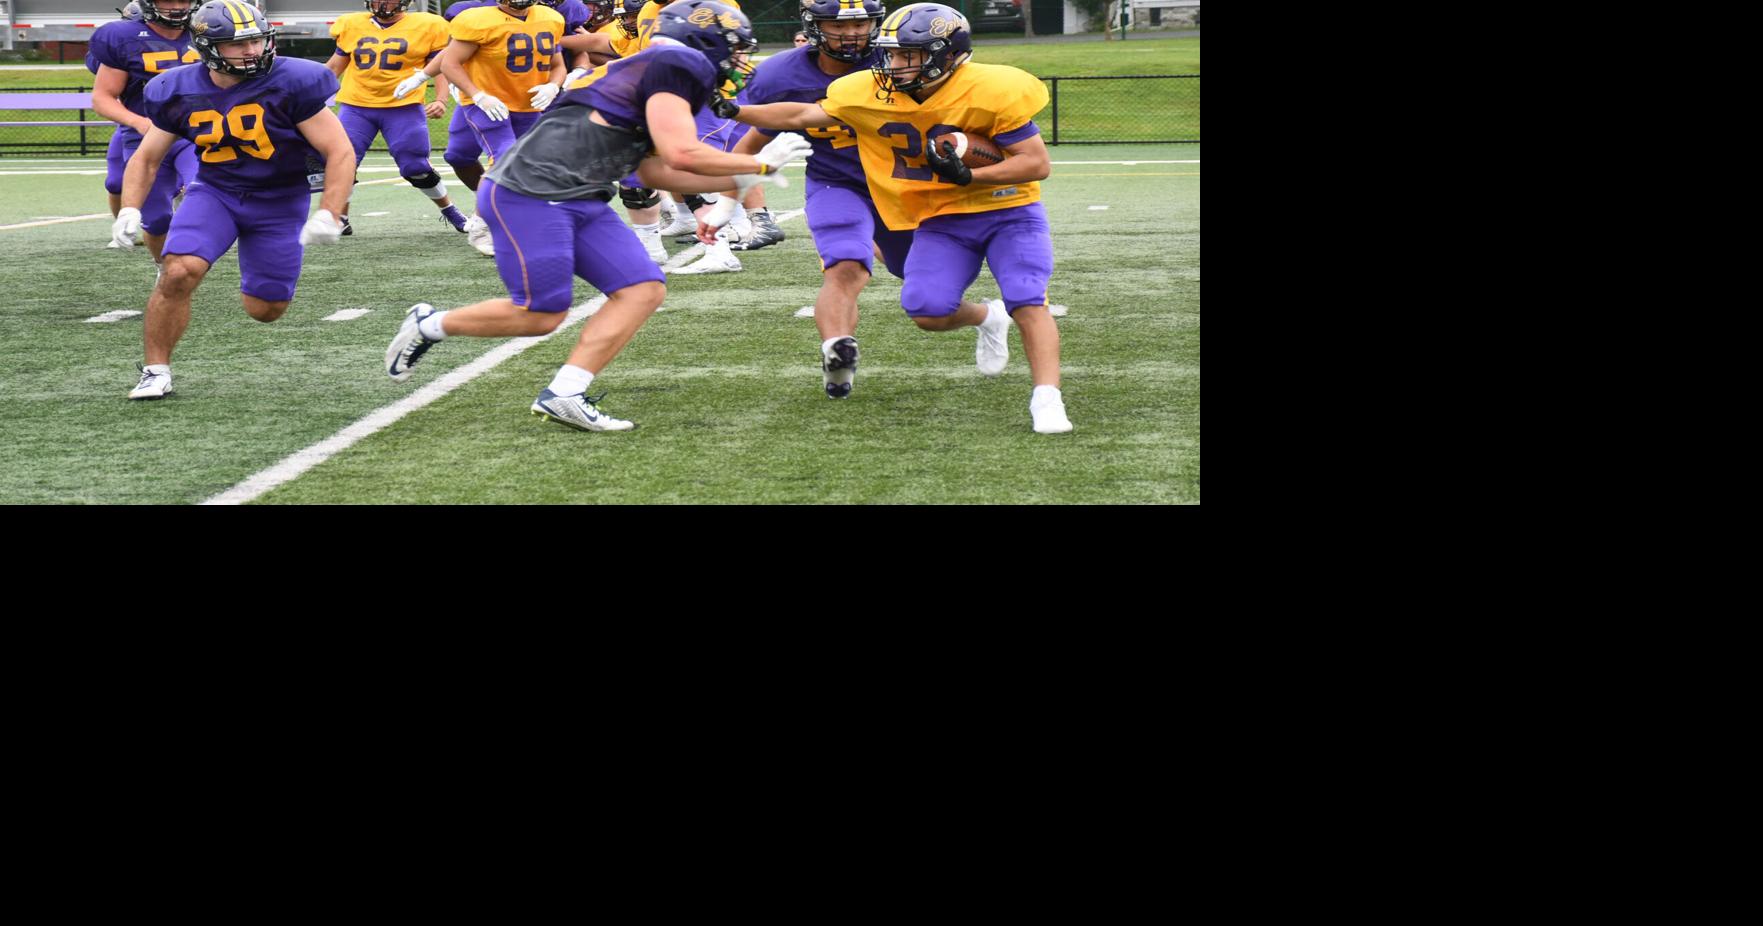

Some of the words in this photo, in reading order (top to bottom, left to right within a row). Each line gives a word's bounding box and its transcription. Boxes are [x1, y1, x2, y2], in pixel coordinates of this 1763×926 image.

[354, 37, 408, 70] 62
[506, 32, 554, 73] 89
[188, 103, 275, 163] 29
